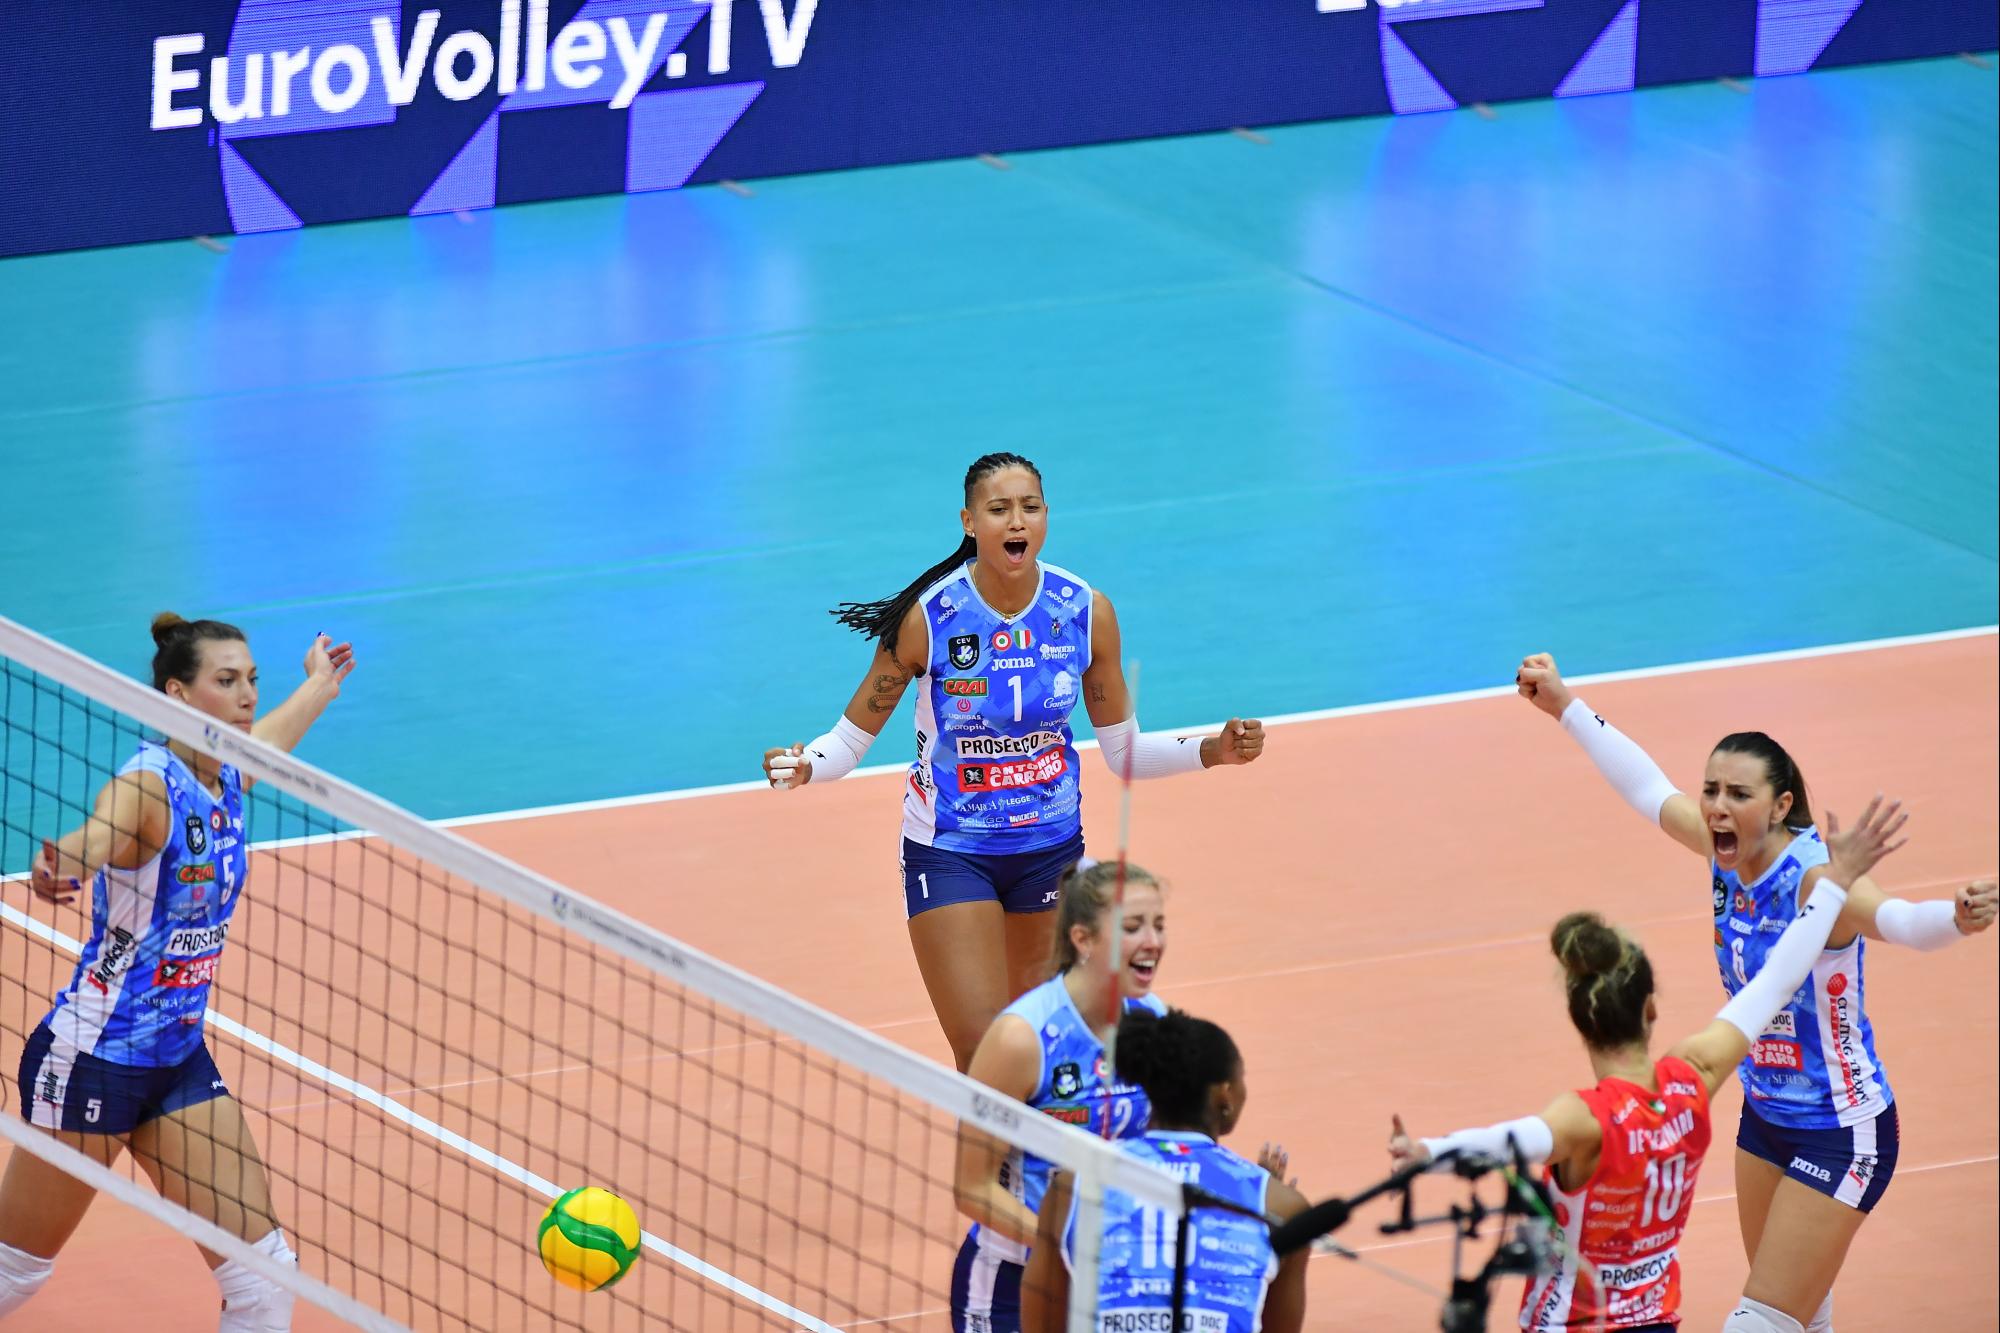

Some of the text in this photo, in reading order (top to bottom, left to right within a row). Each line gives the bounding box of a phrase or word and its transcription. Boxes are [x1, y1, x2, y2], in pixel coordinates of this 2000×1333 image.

[150, 0, 816, 131] EuroVolley.TV
[956, 637, 971, 645] CEV
[945, 681, 986, 695] CRAI
[1007, 675, 1023, 722] 1
[961, 734, 1039, 755] PROSECCO
[989, 758, 1062, 788] CARRARO
[990, 751, 1061, 775] ANTONIO
[221, 855, 235, 906] 5
[918, 873, 929, 899] 1
[84, 1099, 102, 1124] 5
[1640, 1151, 1686, 1229] 10
[1103, 1312, 1194, 1333] PROSECO
